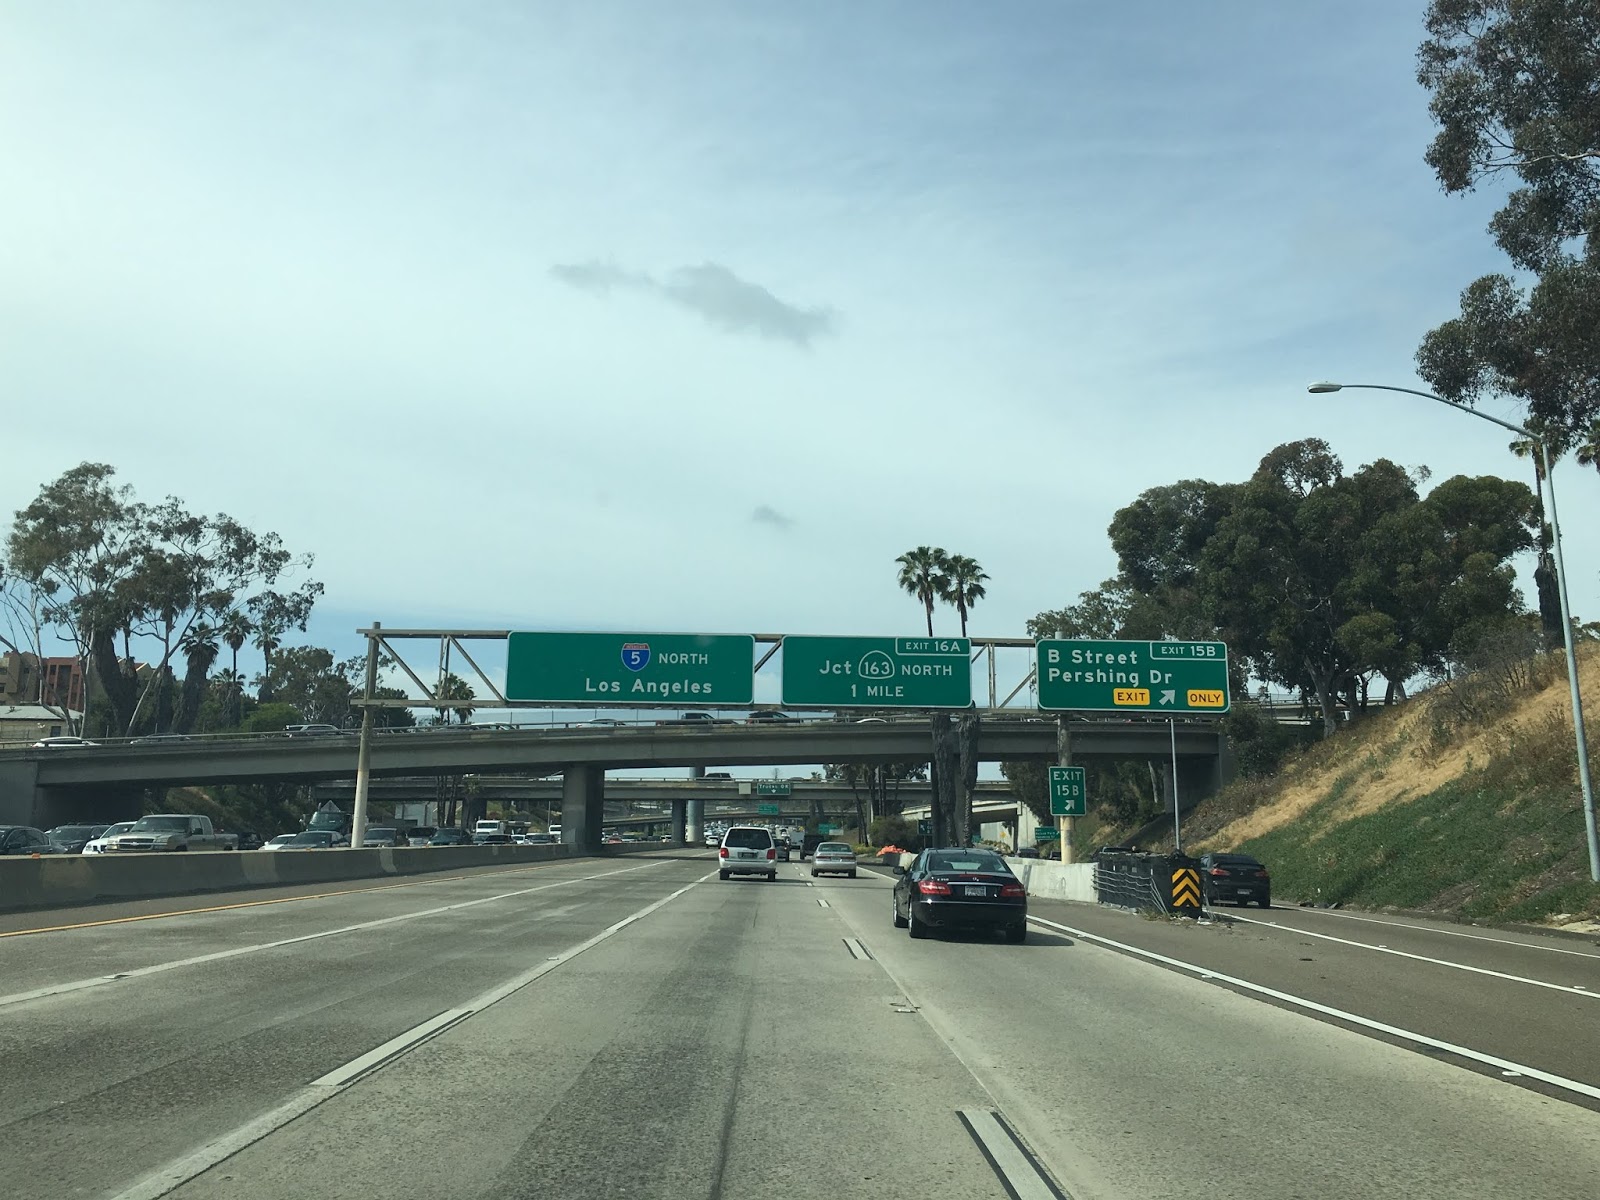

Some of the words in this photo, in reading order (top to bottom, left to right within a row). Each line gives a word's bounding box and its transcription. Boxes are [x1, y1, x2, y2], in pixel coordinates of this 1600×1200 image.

[906, 642, 929, 650] EXIT
[935, 641, 961, 652] 16A
[1162, 646, 1185, 654] EXIT
[1190, 646, 1216, 657] 15B
[630, 651, 640, 665] 5
[658, 653, 708, 664] NORTH
[1048, 649, 1060, 663] B
[1072, 649, 1138, 664] Street
[819, 660, 851, 675] Jct
[864, 662, 890, 675] 163
[902, 665, 952, 676] NORTH
[1049, 668, 1139, 688] Pershing
[1150, 670, 1172, 684] Dr
[585, 678, 620, 692] Los
[631, 679, 712, 697] Angeles
[851, 684, 856, 697] 1
[867, 686, 904, 697] MILE
[1117, 692, 1146, 702] EXIT
[1190, 693, 1221, 703] ONLY
[1053, 771, 1081, 780] EXIT
